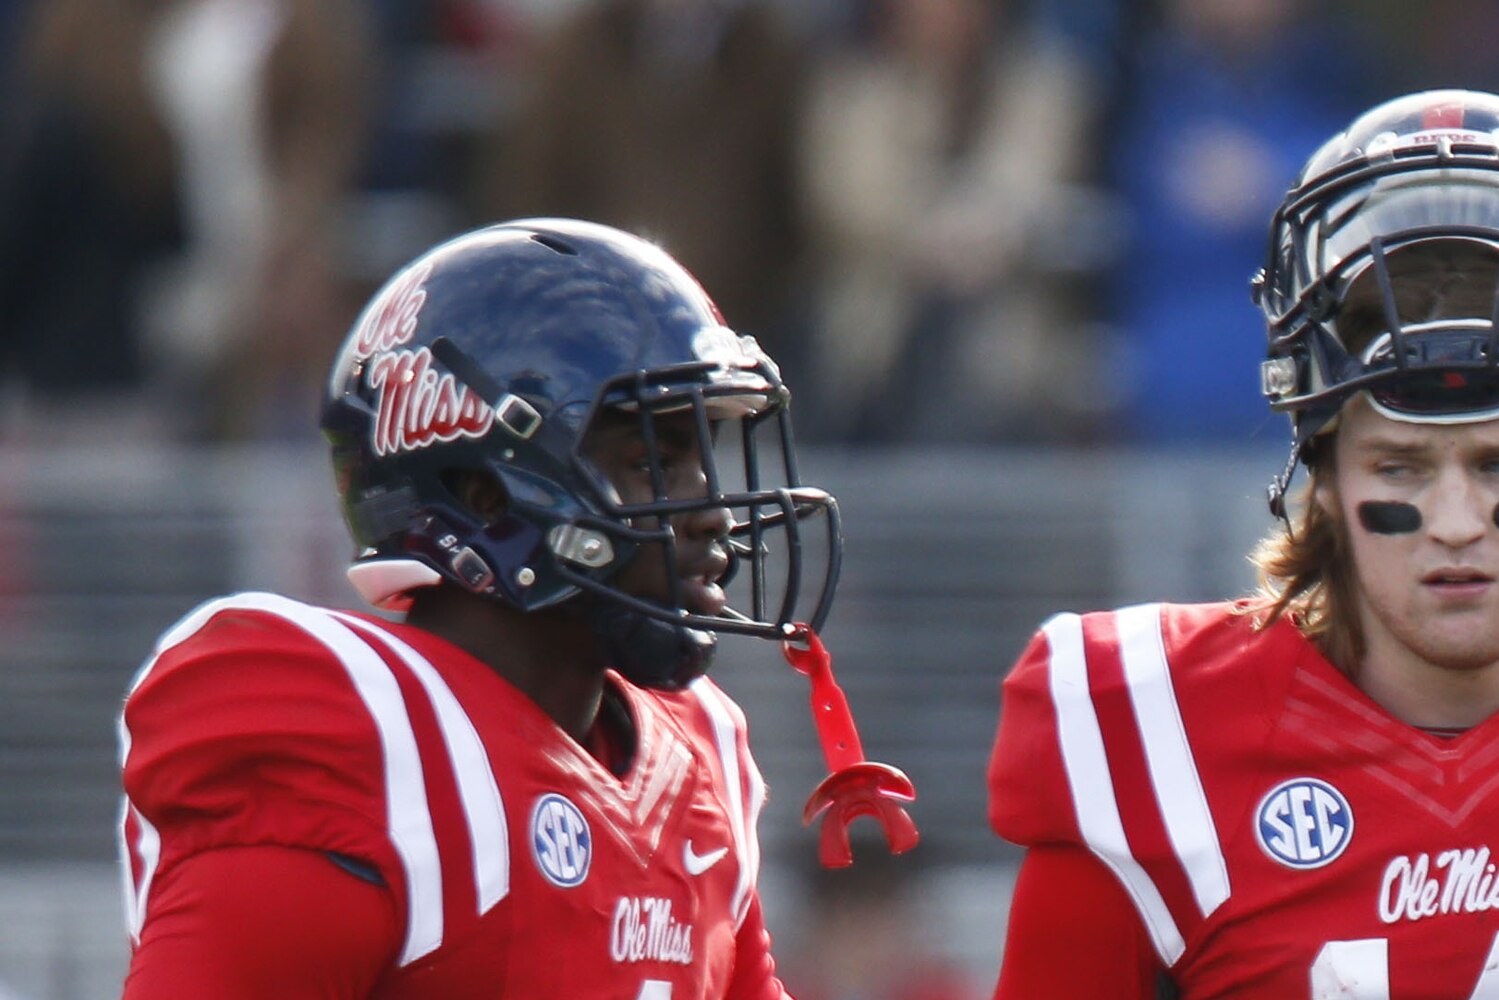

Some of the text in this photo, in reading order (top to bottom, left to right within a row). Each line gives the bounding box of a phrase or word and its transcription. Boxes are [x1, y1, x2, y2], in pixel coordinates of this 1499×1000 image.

[354, 262, 434, 358] Ole
[370, 347, 494, 456] Miss
[536, 800, 588, 879] SEC
[1261, 785, 1345, 860] SEC
[1378, 852, 1439, 924] Ole
[611, 896, 694, 965] Ole Miss
